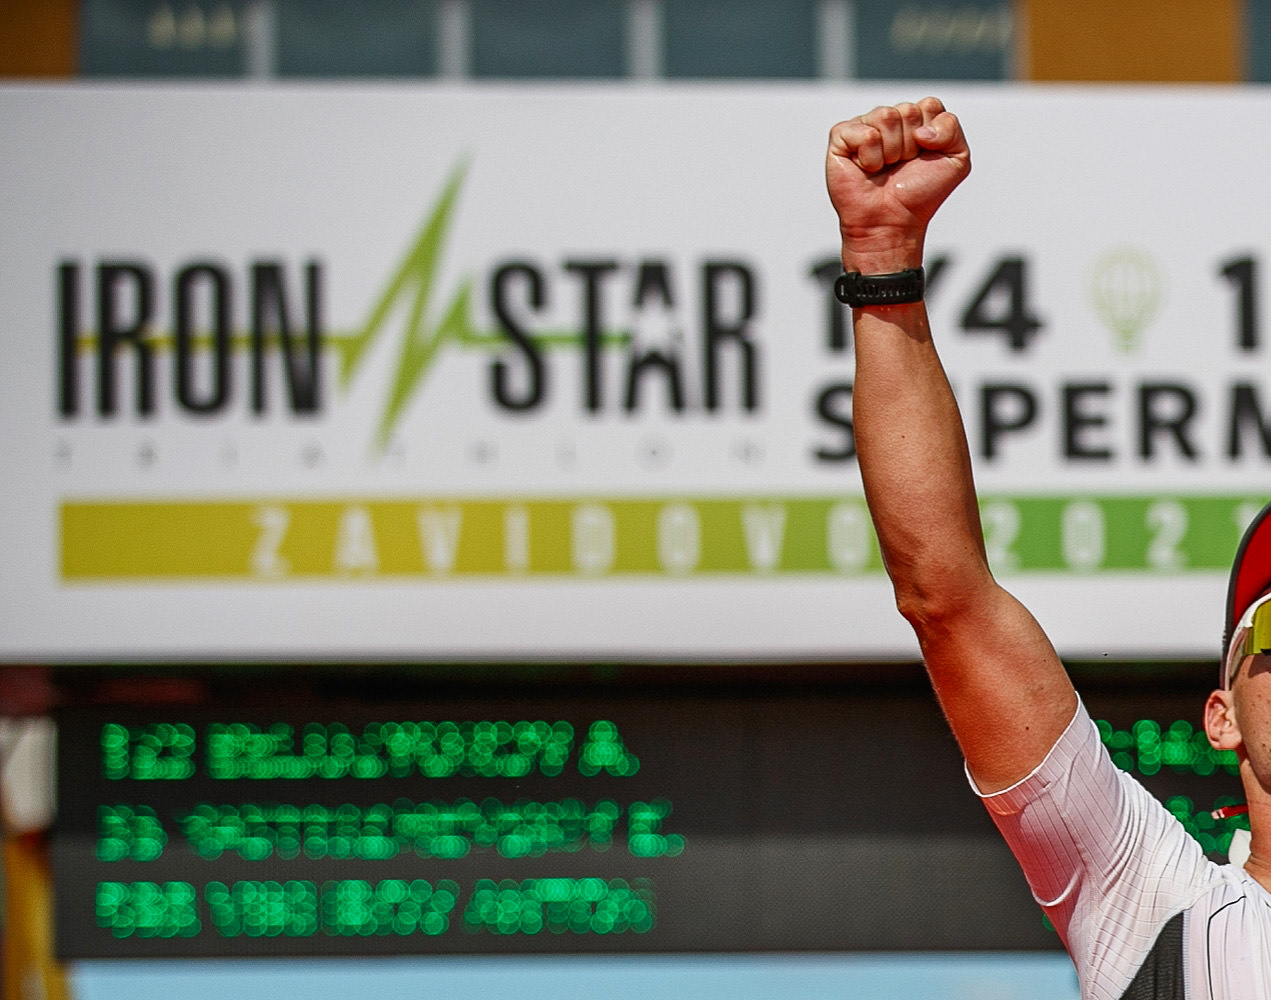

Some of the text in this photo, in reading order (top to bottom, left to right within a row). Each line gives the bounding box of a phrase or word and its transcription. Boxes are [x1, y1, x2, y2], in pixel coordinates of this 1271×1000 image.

[57, 257, 762, 418] IRON STAR
[248, 503, 873, 578] ZAVIDOVO
